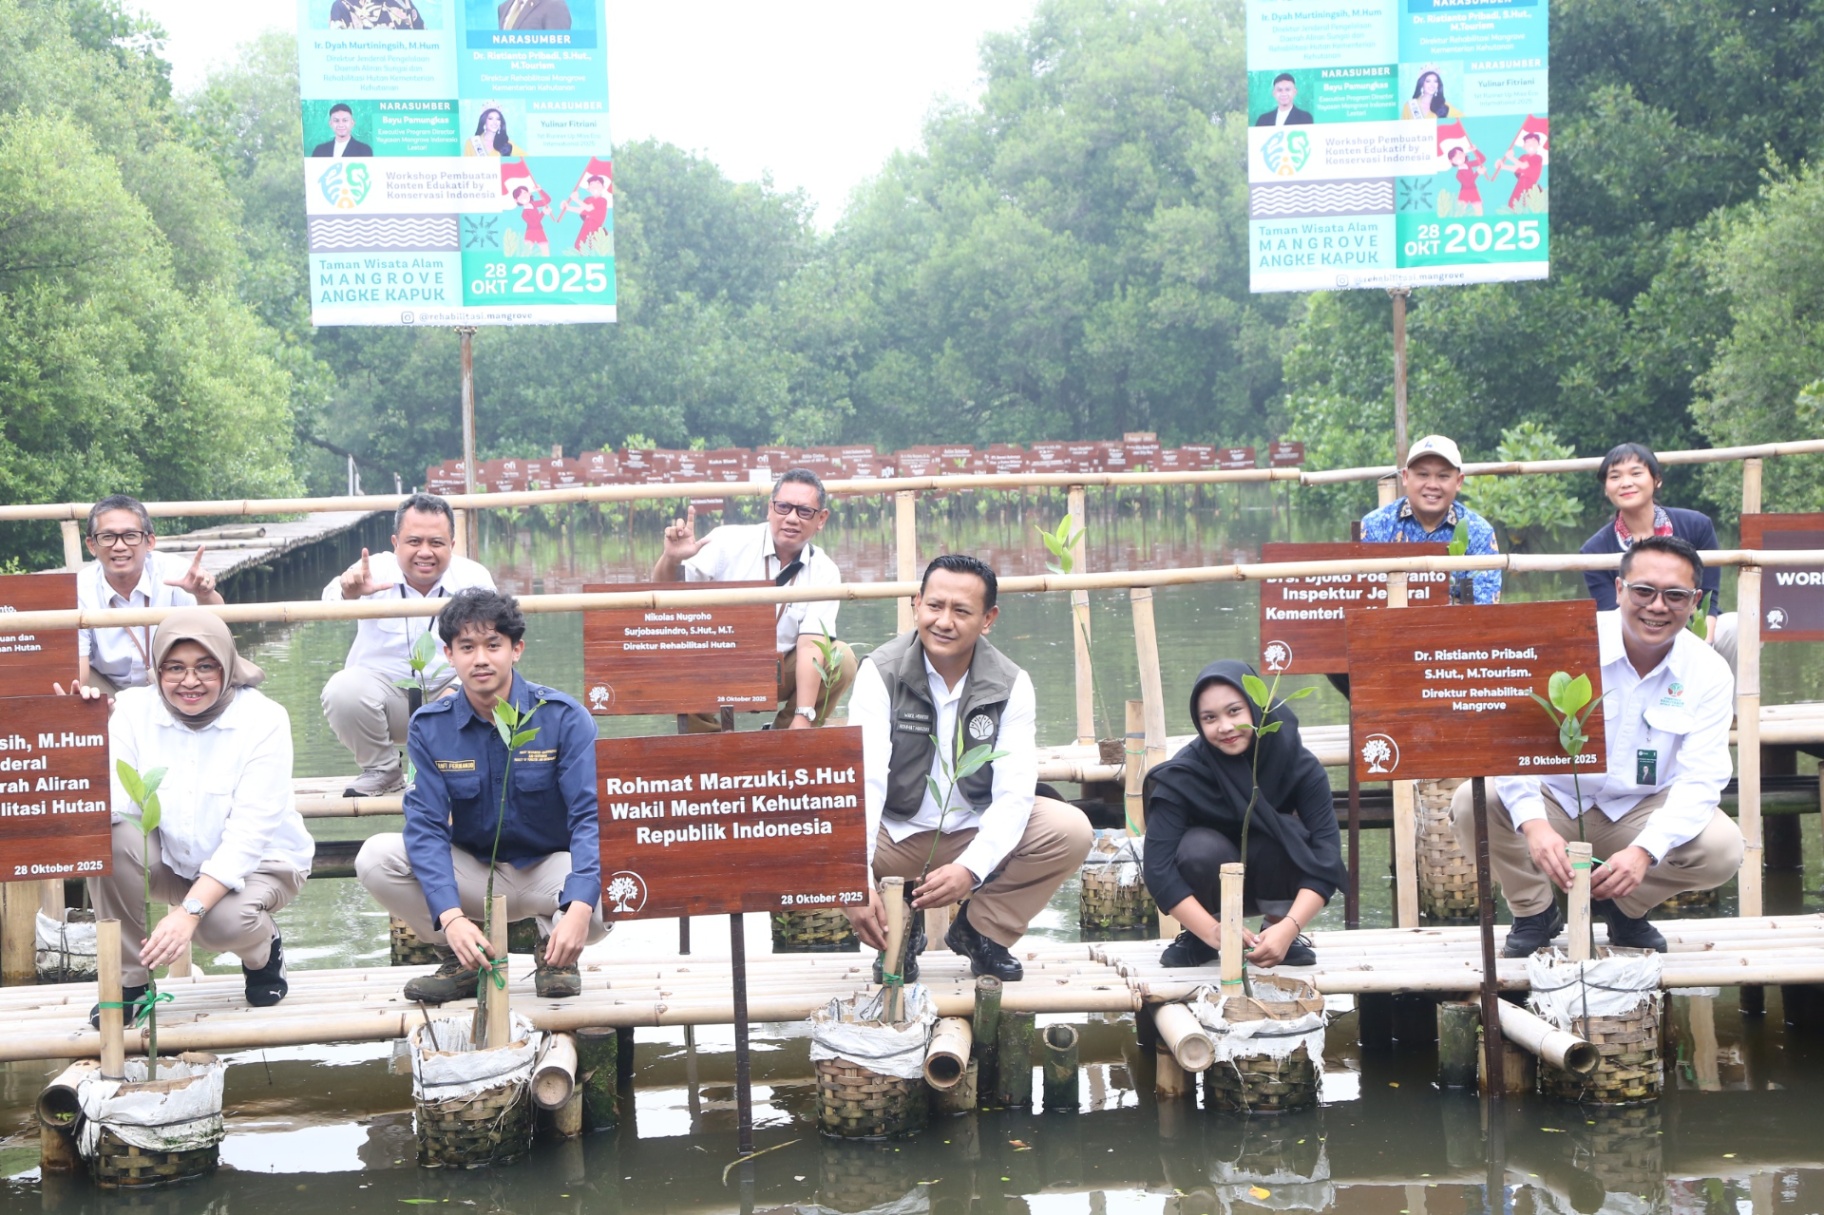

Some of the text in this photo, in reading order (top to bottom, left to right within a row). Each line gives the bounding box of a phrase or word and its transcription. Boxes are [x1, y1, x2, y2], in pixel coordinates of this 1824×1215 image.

[1271, 12, 1293, 23] Dyah
[1294, 10, 1351, 21] Murtiningsih,
[1351, 9, 1382, 17] M.Hum
[1413, 16, 1426, 24] Dr.
[1427, 14, 1467, 23] Ristianto
[1468, 12, 1502, 21] Pribadi,
[1450, 22, 1495, 31] M.Tourism
[314, 41, 440, 52] Ir. Dyah Murtiningsih, M.Hum
[492, 35, 572, 45] NARASUMBER
[473, 51, 485, 60] Dr.
[487, 51, 527, 60] Ristianto
[528, 51, 562, 61] Pribadi,
[510, 61, 555, 70] M.Tourism
[1471, 59, 1541, 70] NARASUMBER
[1321, 66, 1390, 78] NARASUMBER
[551, 75, 586, 84] Mangrove
[1506, 78, 1535, 87] Fitriani
[1323, 81, 1389, 93] Bayu Pamungkas
[380, 102, 451, 111] NARASUMBER
[532, 102, 602, 111] NARASUMBER
[382, 116, 449, 126] Bayu Pamungkas
[540, 120, 597, 128] Yulinar Fitriani
[1325, 134, 1434, 147] Workshop Pembuatan
[1325, 144, 1420, 156] Konten Edukatif by
[1325, 153, 1431, 165] Konservasi Indonesia
[386, 171, 498, 182] Workshop Pembuatan
[386, 181, 484, 192] Konten Edukatif by
[387, 190, 496, 199] Konservasi Indonesia
[1258, 222, 1379, 236] Taman Wisata Alam
[1417, 224, 1440, 239] 28
[1444, 219, 1541, 254] 2025
[1258, 235, 1379, 252] MANGROVE
[1404, 239, 1442, 257] OKT
[319, 257, 443, 270] Taman Wisata Alam
[1258, 251, 1379, 268] ANGKE KAPUK
[484, 263, 507, 278] 28
[320, 271, 445, 287] MANGROVE
[511, 262, 608, 293] 2025
[471, 279, 509, 295] OKT
[321, 287, 445, 303] ANGKE KAPUK
[1282, 587, 1364, 603] Inspektur
[644, 612, 712, 623] Nikolas Nugroho
[1265, 606, 1346, 620] Kementeri
[18, 633, 35, 641] dan
[624, 625, 735, 638] Surjobasuindro, S.Hut., M.T.
[13, 644, 42, 653] Hutan
[623, 640, 737, 651] Direktur Rehabilitasi Hutan
[1414, 647, 1538, 662] Dr. Ristianto Pribadi,
[1424, 666, 1532, 681] S.Hut., M.Tourism.
[1421, 688, 1466, 699] Direktur
[1452, 701, 1507, 713] Mangrove
[38, 731, 105, 749] M.Hum
[0, 755, 47, 772] deral
[1518, 753, 1597, 767] 28 Oktober 2025
[35, 776, 90, 792] Aliran
[606, 774, 694, 796] Rohmat
[0, 798, 107, 817] litasi Hutan
[609, 793, 858, 820] Wakil Menteri Kehutanan
[636, 817, 833, 847] Republik Indonesia
[13, 860, 104, 876] 28 Oktober 2025
[780, 892, 863, 905] 28 Oktober 2025
